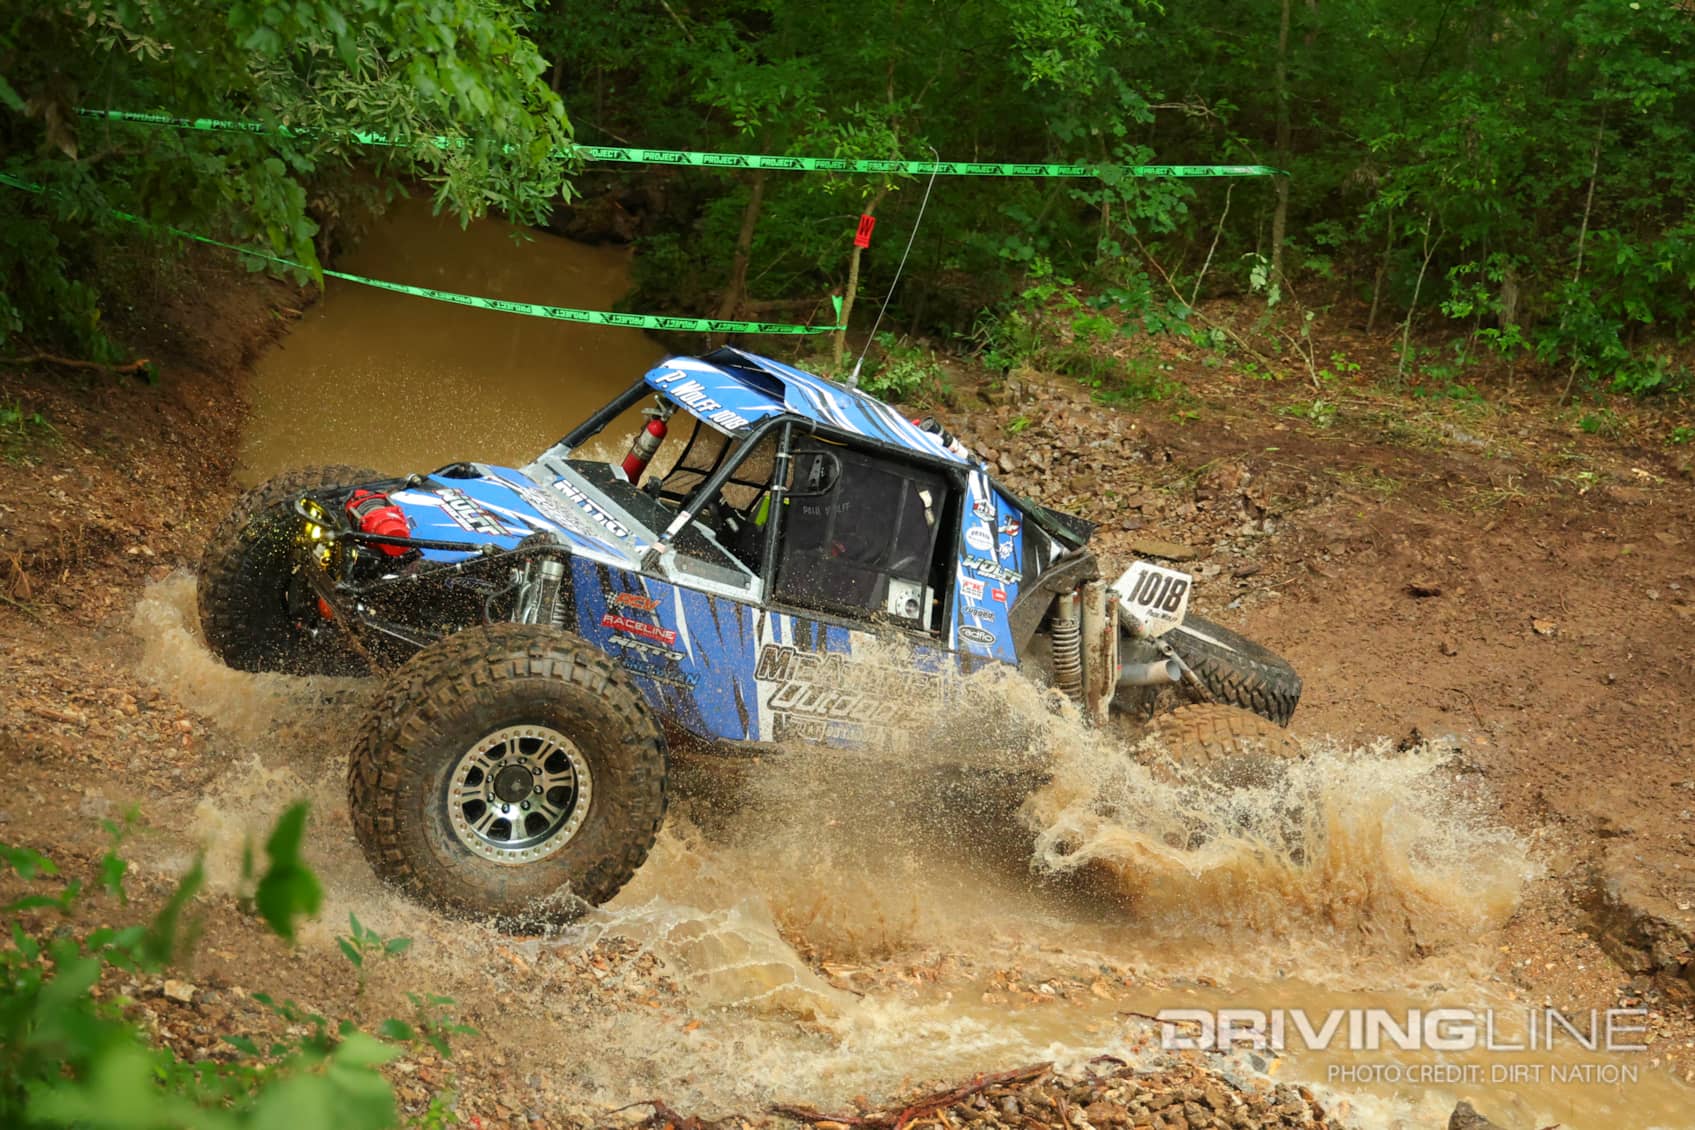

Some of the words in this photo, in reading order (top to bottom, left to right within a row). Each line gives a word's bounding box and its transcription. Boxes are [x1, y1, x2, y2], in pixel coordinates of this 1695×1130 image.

[643, 151, 679, 162] PROJECT
[703, 155, 737, 165] PROJECT
[761, 158, 793, 167] PROJECT
[816, 160, 846, 170] PROJECT
[557, 309, 590, 321] PROJECT
[613, 315, 646, 326] PROJECT
[667, 319, 698, 330] PROJECT
[655, 369, 687, 389] P.
[670, 380, 724, 412] WOLFF
[1127, 569, 1188, 613] 1018
[602, 614, 676, 640] RACELINE
